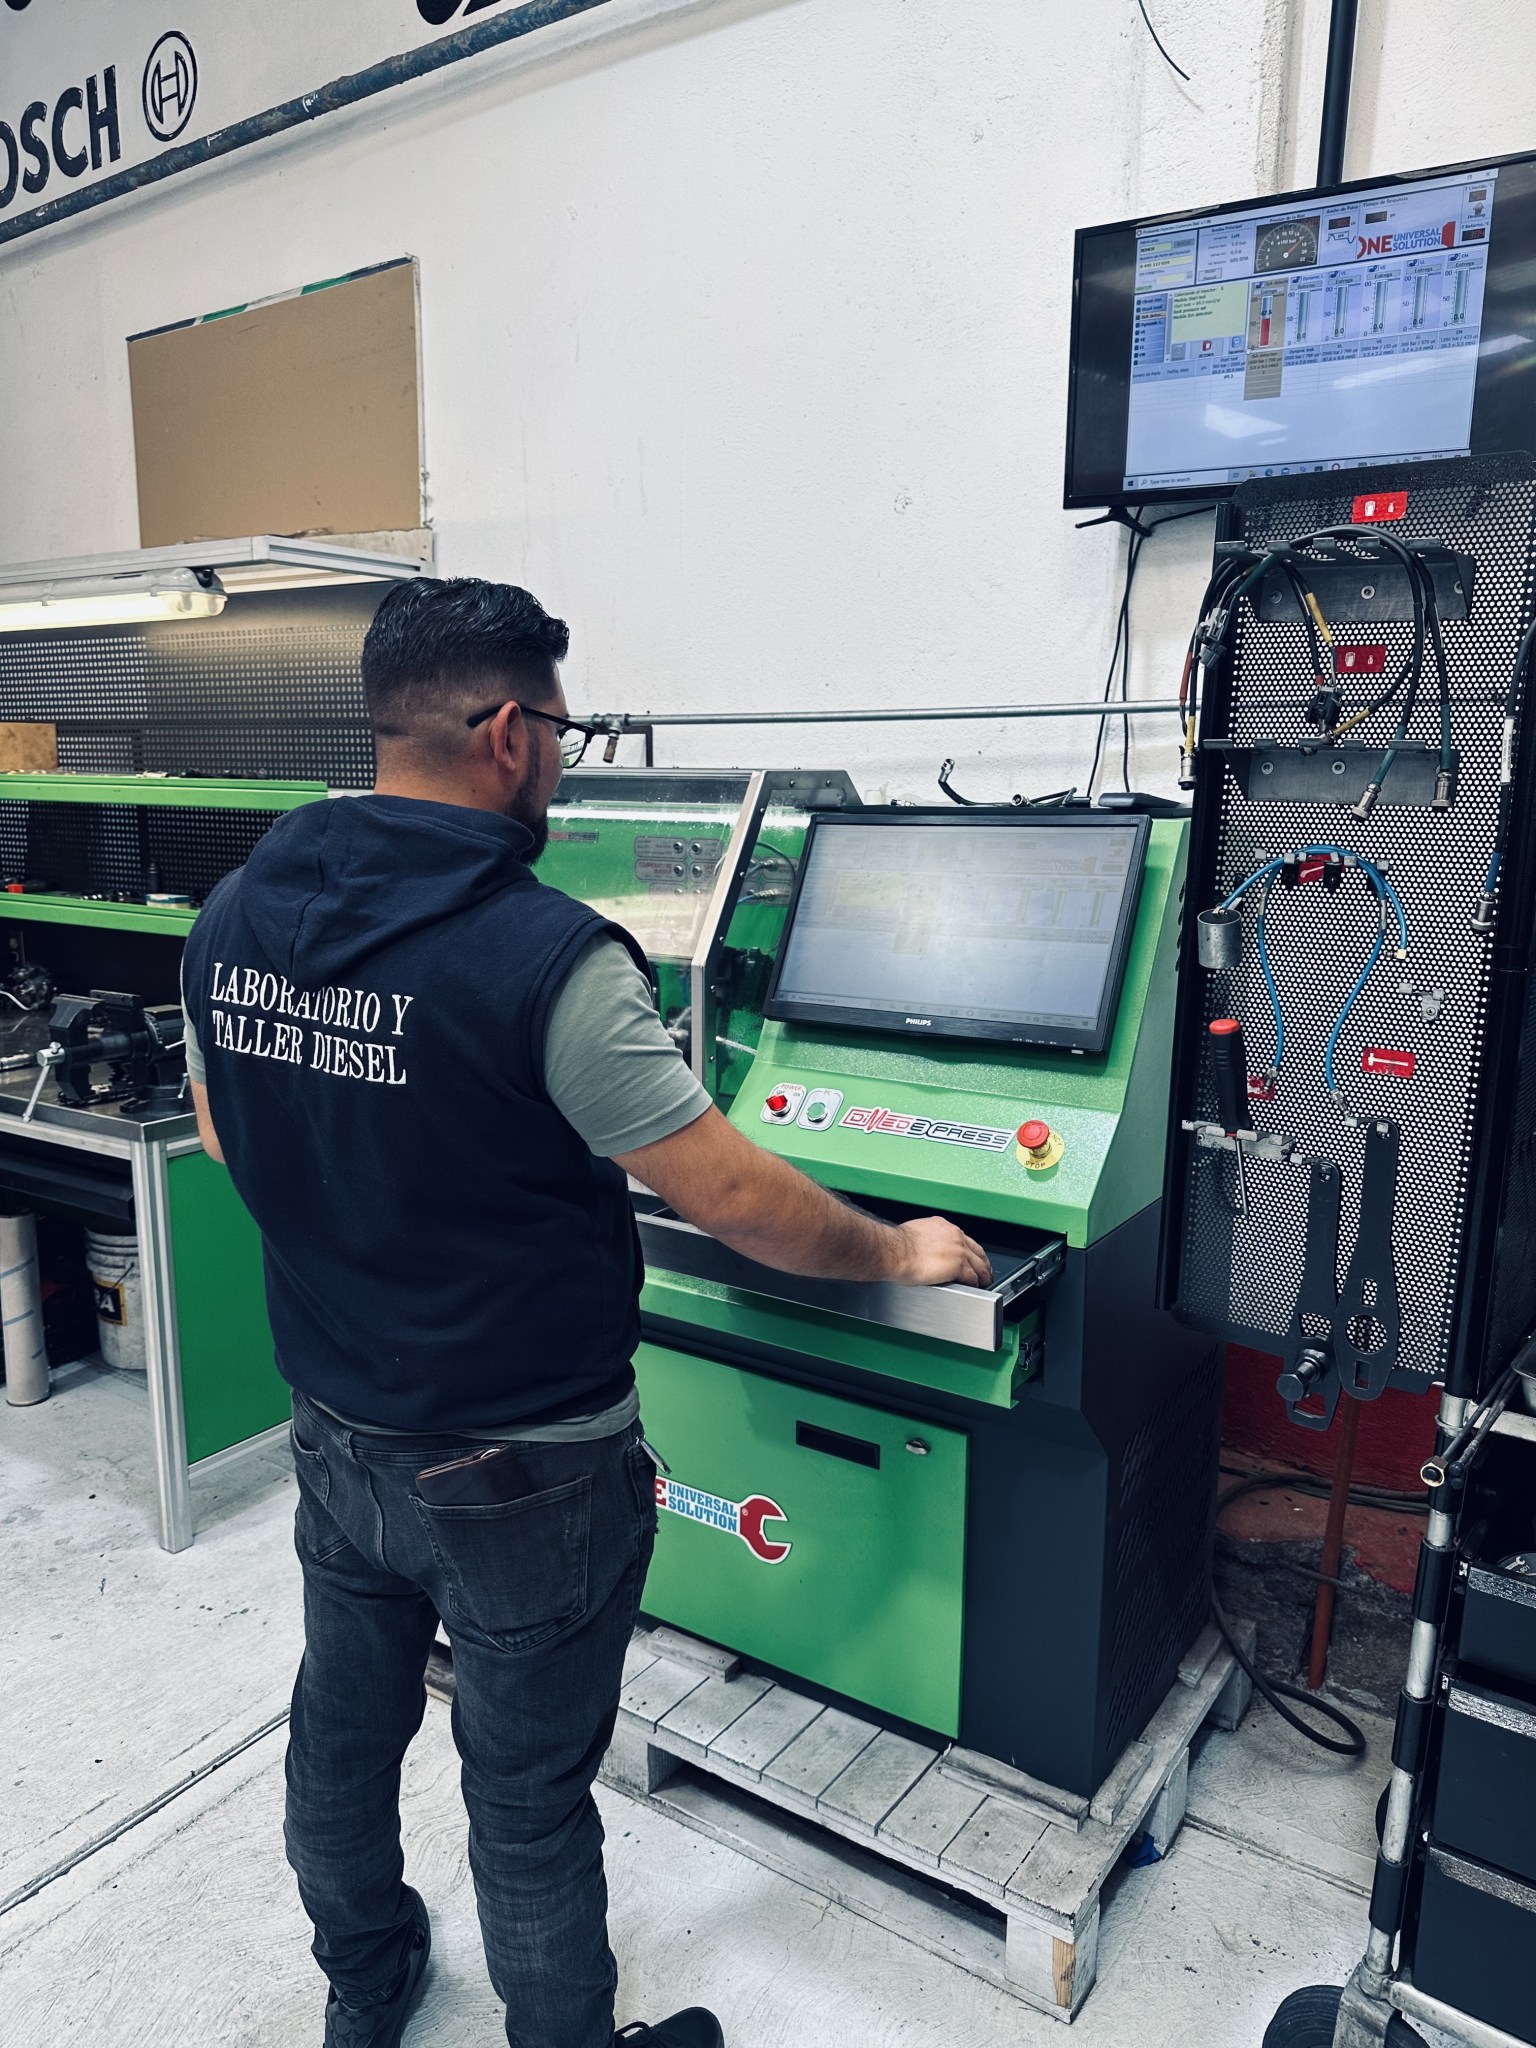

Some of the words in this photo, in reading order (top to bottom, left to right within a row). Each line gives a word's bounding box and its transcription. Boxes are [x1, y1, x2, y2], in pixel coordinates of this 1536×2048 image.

[1392, 236, 1440, 251] SOLUTION
[1393, 228, 1442, 241] UNIVERSAL
[210, 962, 380, 1032] LABORATORIO
[391, 994, 414, 1036] Y
[905, 1017, 931, 1027] PHILIPS
[212, 1010, 304, 1065] TALLER
[310, 1031, 407, 1084] DIESEL
[1024, 1160, 1045, 1168] STOP
[668, 1482, 737, 1518] UNIVERSAL
[668, 1496, 737, 1532] SOLUTION
